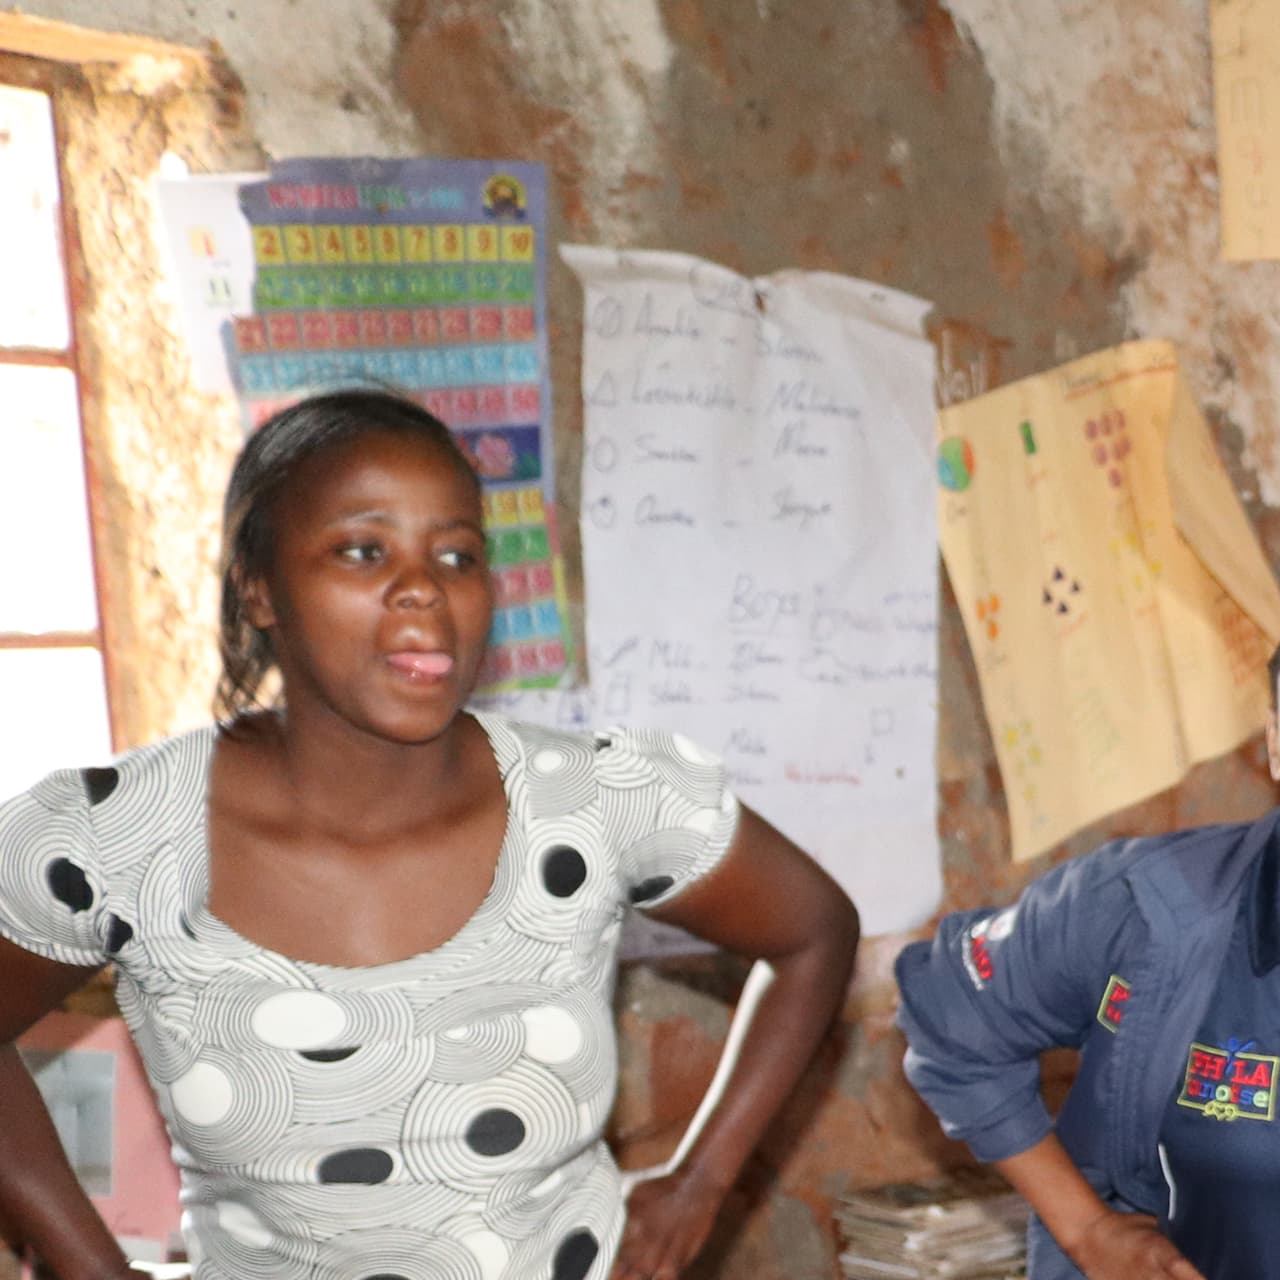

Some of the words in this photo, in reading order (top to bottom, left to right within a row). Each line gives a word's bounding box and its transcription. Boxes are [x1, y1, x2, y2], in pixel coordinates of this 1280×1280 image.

[260, 228, 278, 257] 2
[298, 228, 313, 257] 3
[325, 228, 342, 254] 4
